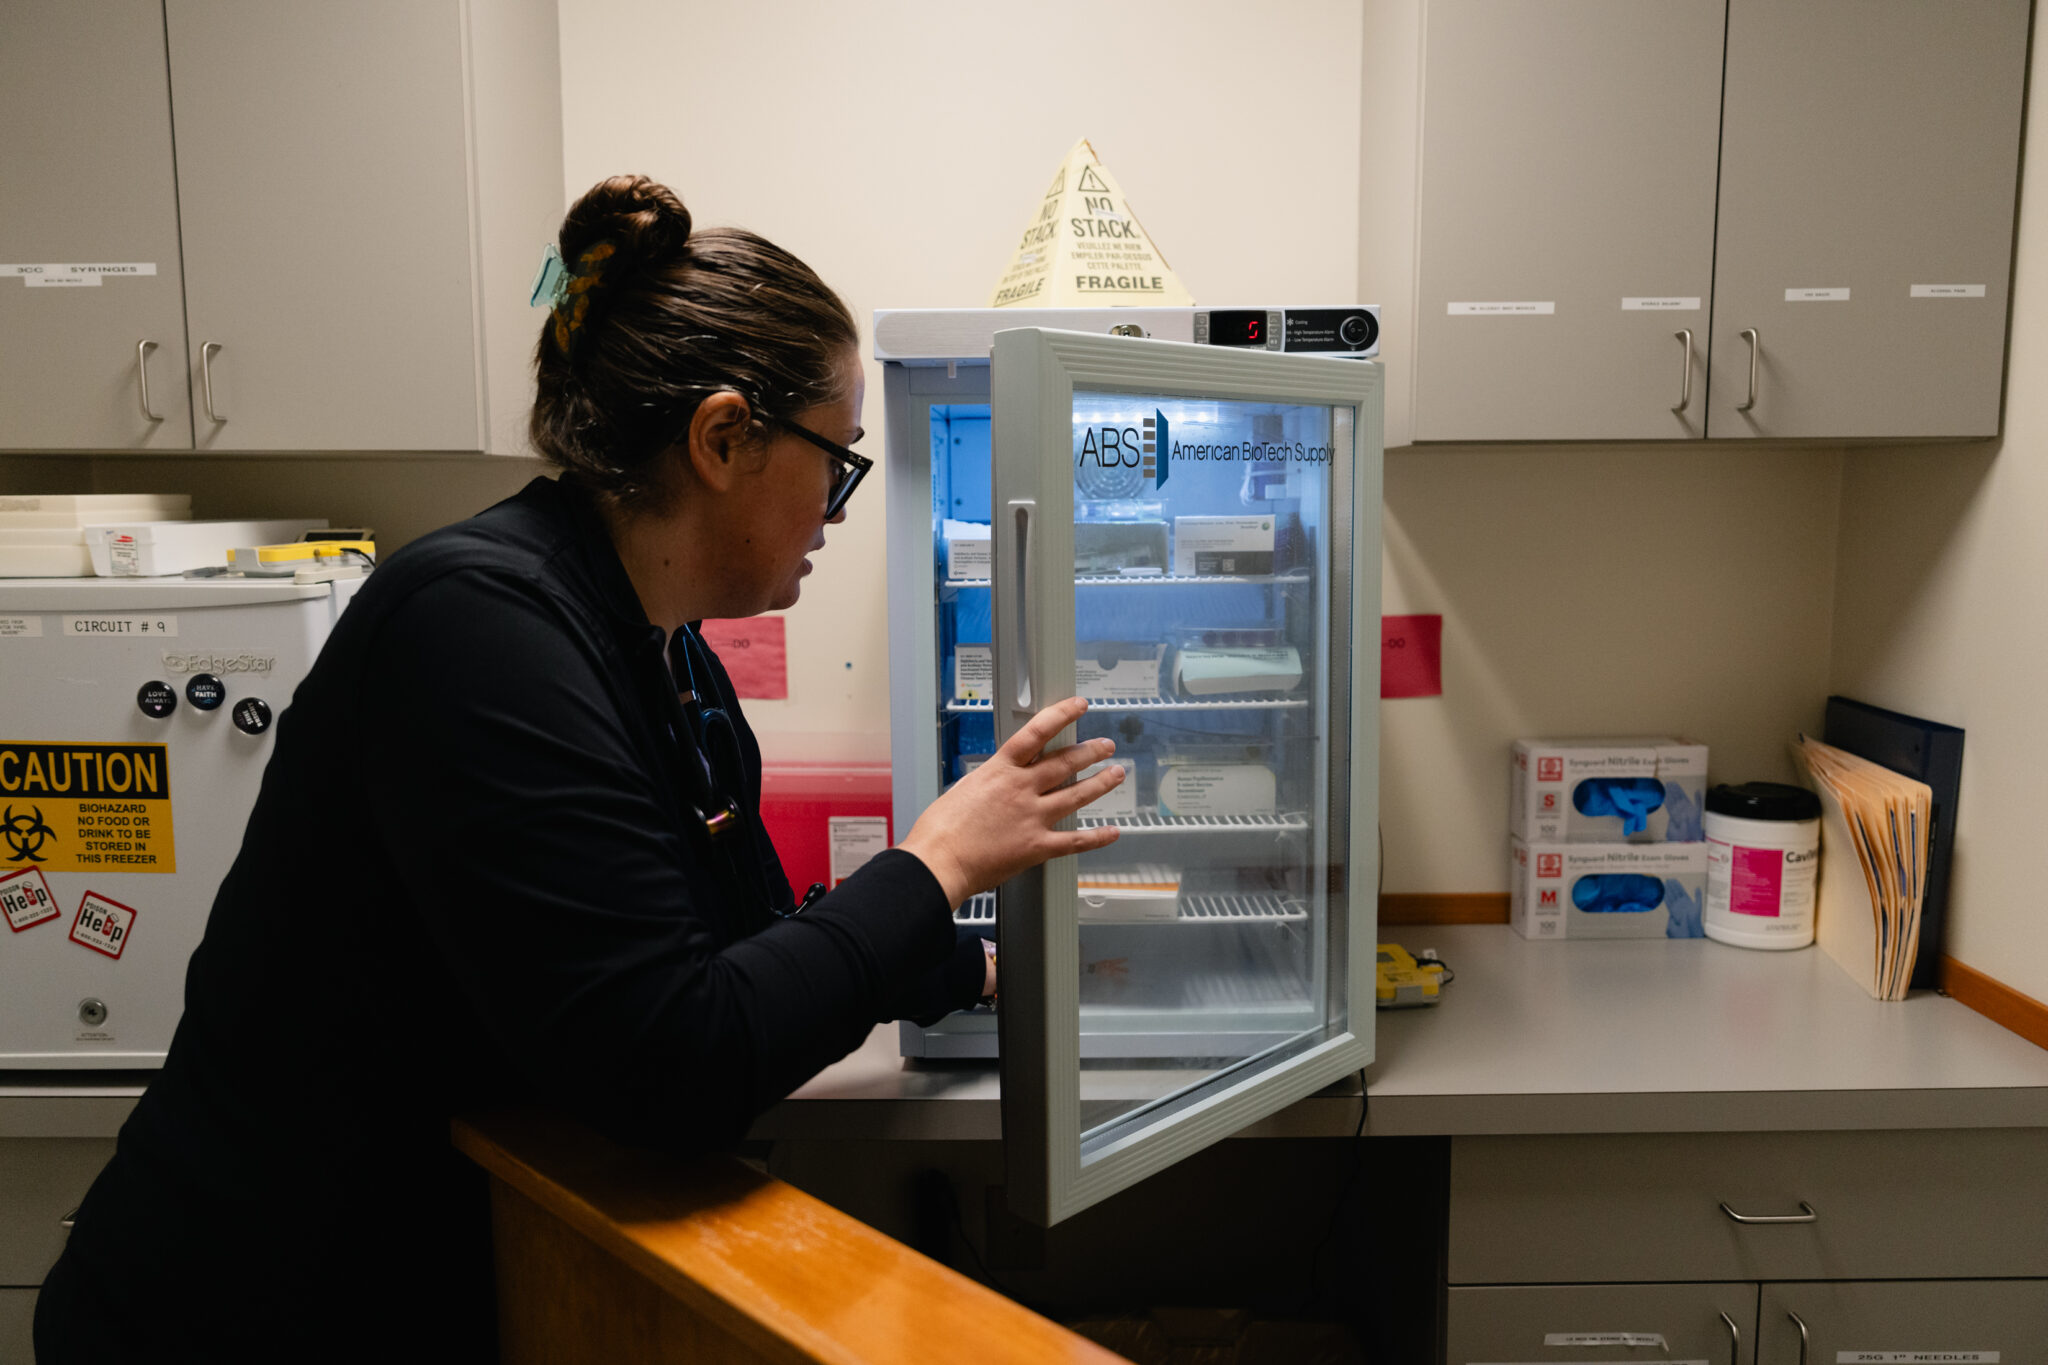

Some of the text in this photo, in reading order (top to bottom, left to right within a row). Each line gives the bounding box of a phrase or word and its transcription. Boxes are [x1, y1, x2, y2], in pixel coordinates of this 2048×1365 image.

[1076, 276, 1164, 289] FRAGILE
[995, 277, 1046, 304] FRAGILE
[1079, 427, 1335, 468] ABS American BioTech Supply
[75, 621, 165, 633] CIRCUIT # 9
[189, 654, 275, 676] EdgeStar
[1608, 755, 1640, 765] Nitrile
[0, 750, 158, 793] CAUTION
[1544, 794, 1555, 807] S
[79, 804, 146, 814] BIOHAZARD
[78, 817, 150, 826] NO FOOD OR
[79, 829, 151, 839] DRINK TO BE
[86, 841, 146, 851] STORED IN
[76, 854, 157, 864] THIS FREEZER
[1607, 852, 1639, 861] Nitrile
[3, 888, 47, 914] Help
[1541, 890, 1557, 904] M
[79, 908, 123, 942] Help
